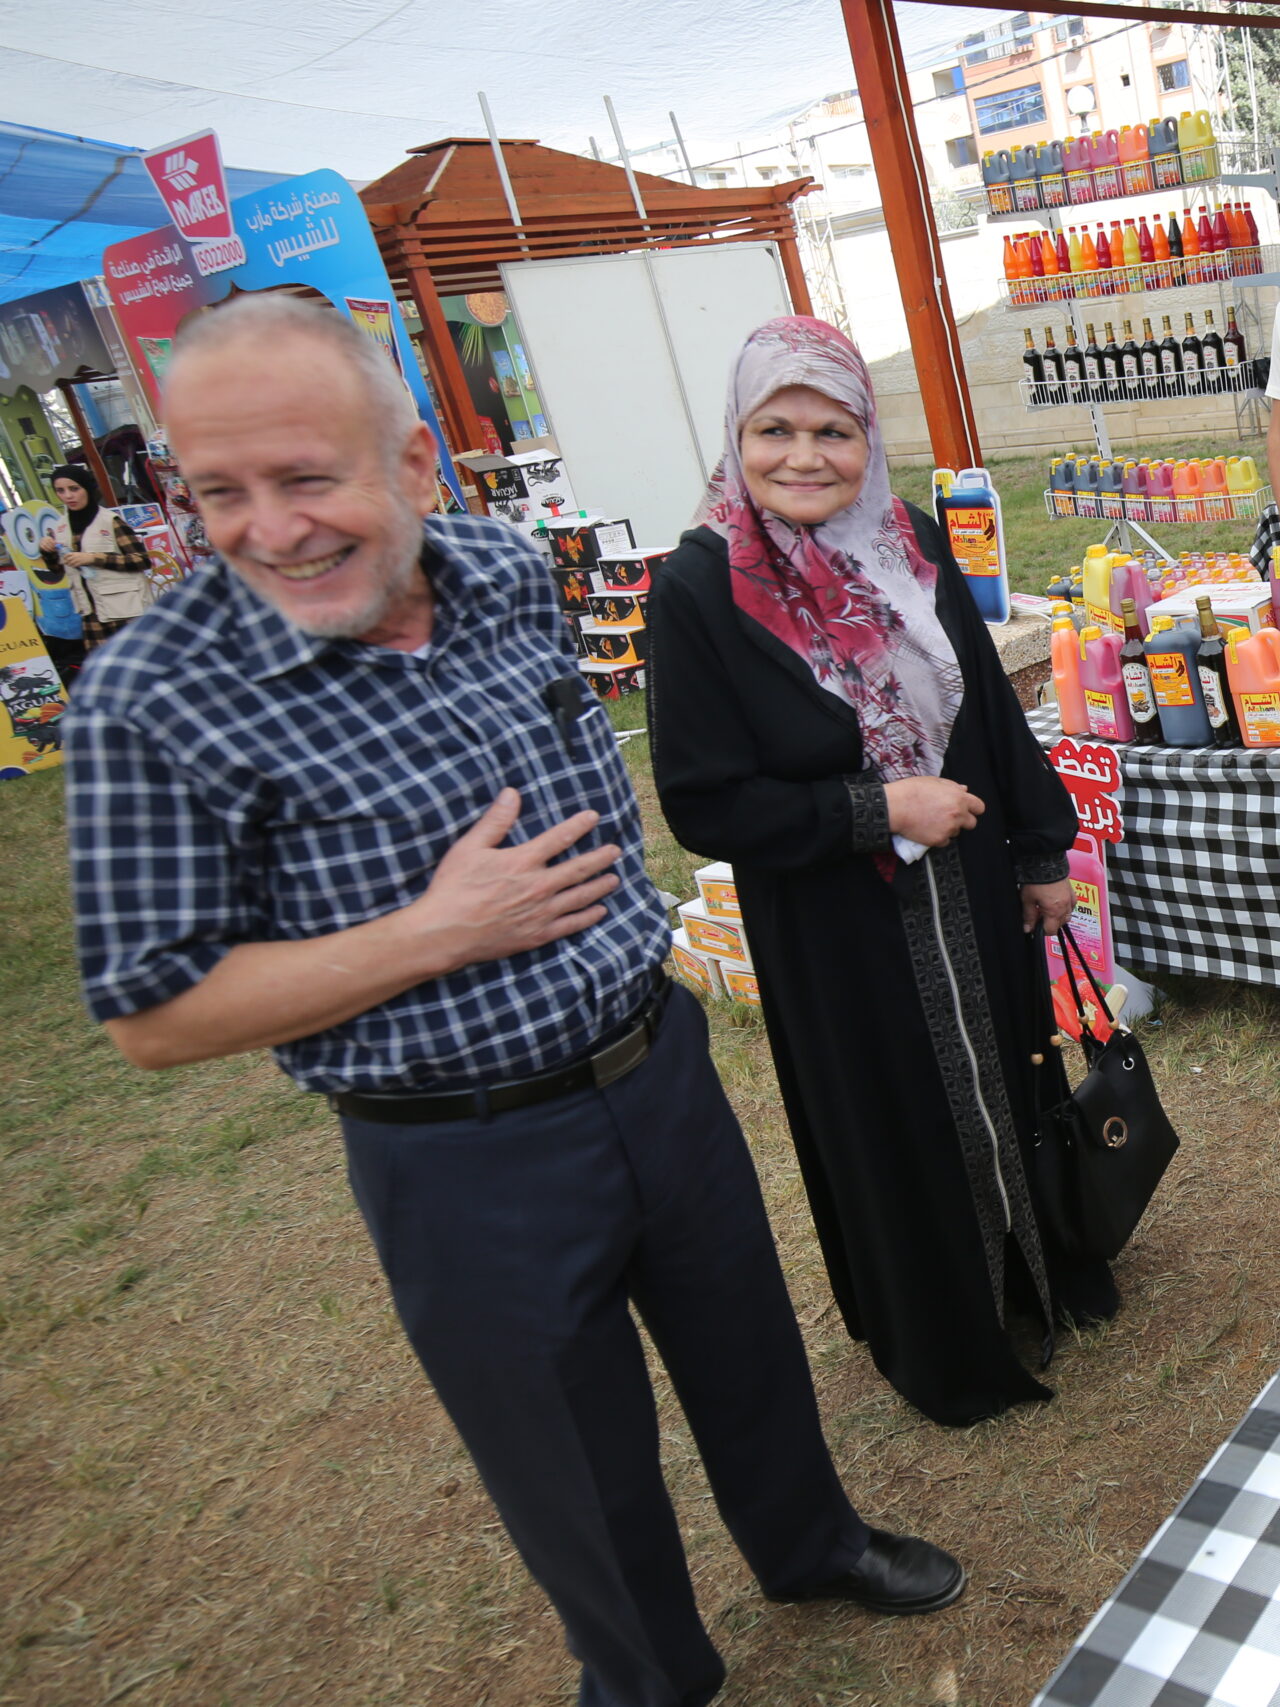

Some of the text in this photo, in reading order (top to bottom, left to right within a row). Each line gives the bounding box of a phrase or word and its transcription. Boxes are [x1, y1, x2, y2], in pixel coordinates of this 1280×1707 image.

[246, 190, 341, 231] مصنع شركة مأرب
[196, 240, 243, 272] ISO22000
[267, 216, 340, 267] للشيبس
[108, 260, 141, 279] صناعة
[949, 511, 987, 533] الشام
[1245, 694, 1276, 706] الشام
[1055, 749, 1112, 784] تفض
[1071, 793, 1115, 834] بزيا
